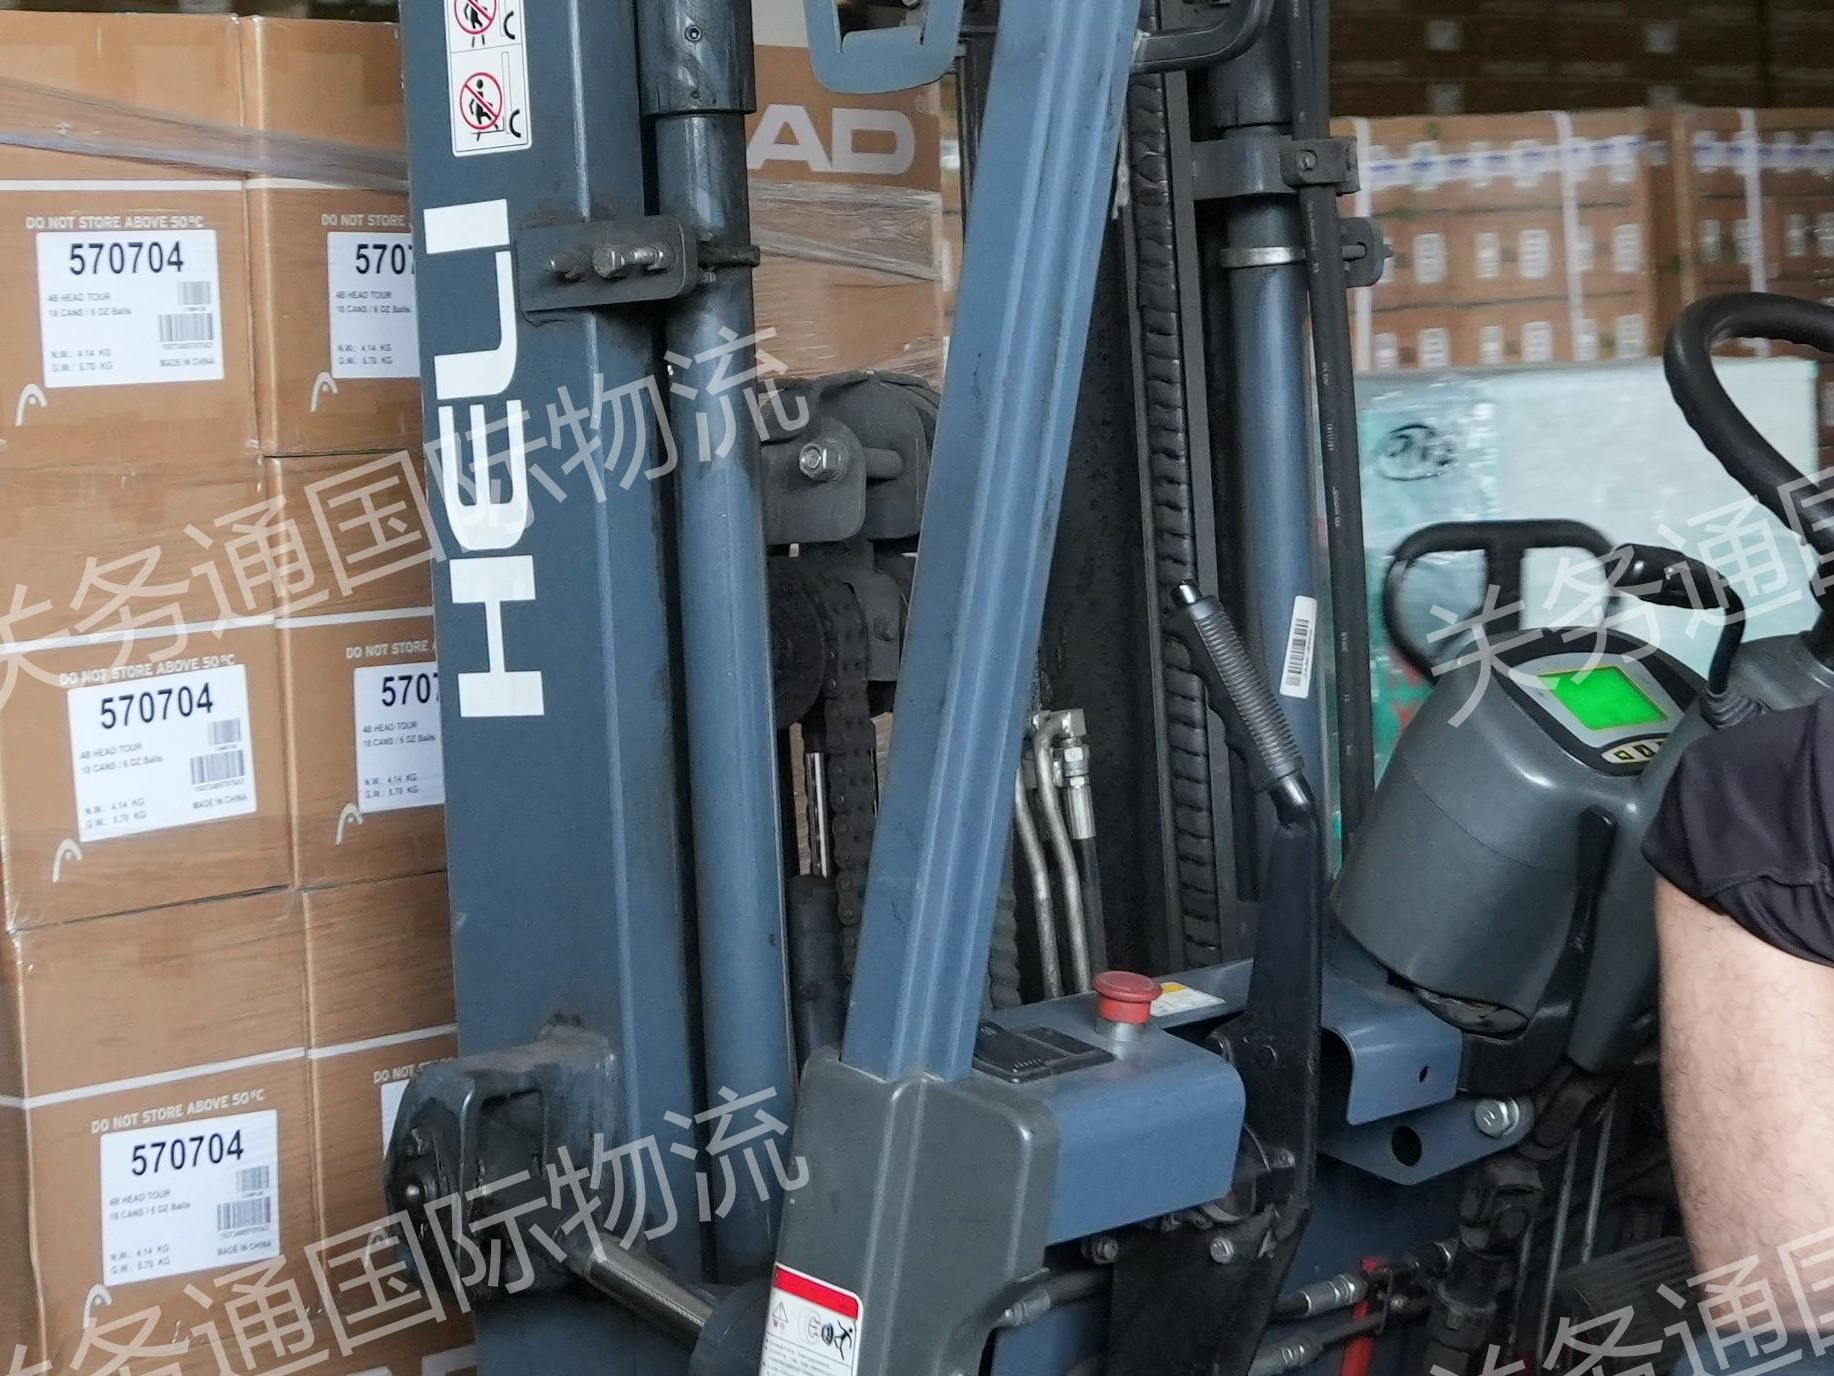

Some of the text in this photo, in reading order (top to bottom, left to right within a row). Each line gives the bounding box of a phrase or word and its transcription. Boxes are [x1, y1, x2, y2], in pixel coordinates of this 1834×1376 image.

[26, 215, 204, 229] DO NOT STORE ABOVE 50°C
[70, 241, 184, 275] 570704
[423, 198, 546, 718] HELI
[100, 683, 213, 730] 570704
[91, 1089, 265, 1134] DO NOT STORE ABOVE 50°C
[131, 1128, 244, 1176] 570704
